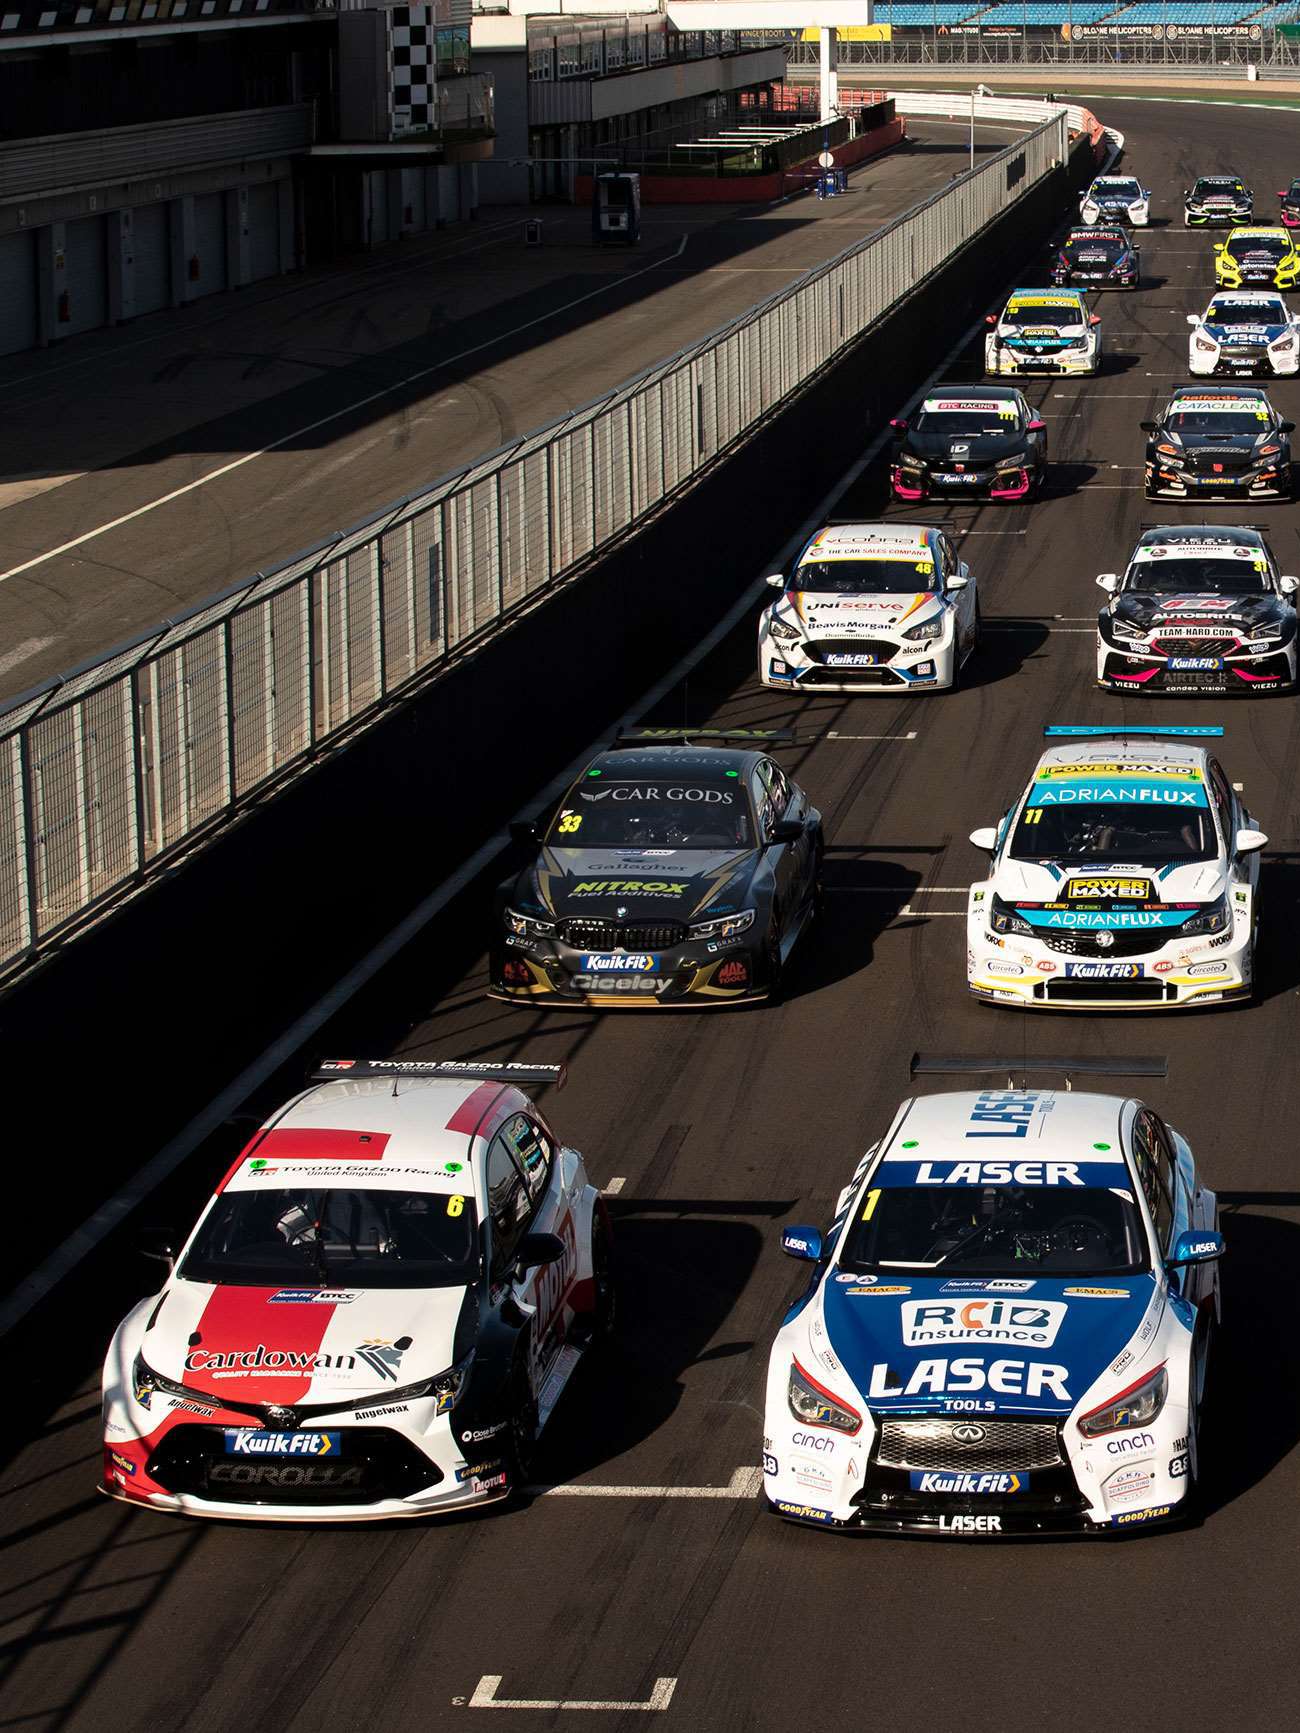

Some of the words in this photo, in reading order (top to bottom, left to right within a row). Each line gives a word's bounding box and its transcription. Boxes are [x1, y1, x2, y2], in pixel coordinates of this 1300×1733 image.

[1218, 334, 1270, 342] LASER
[1177, 402, 1260, 410] CATACLEAN
[915, 563, 931, 574] 48
[1254, 561, 1267, 573] 31
[1152, 613, 1243, 621] AUTOBRITE
[903, 646, 923, 654] alcon
[1115, 681, 1139, 689] VIEZU
[1163, 673, 1214, 683] AIRTEC
[1123, 766, 1191, 774] MAXED
[612, 787, 659, 800] CAR
[666, 789, 734, 804] GODS
[559, 815, 582, 832] 33
[1025, 809, 1043, 824] 11
[573, 882, 690, 893] NITROX
[1075, 880, 1145, 888] POWER
[1075, 887, 1146, 898] MAXED
[1038, 962, 1054, 970] ABS
[569, 974, 674, 993] Ciceley
[916, 1162, 1086, 1185] LASER
[447, 1195, 464, 1216] 6
[862, 1188, 881, 1221] 1
[784, 1236, 808, 1251] LASER
[1190, 1240, 1218, 1253] LASER
[911, 1328, 1047, 1344] Insurance
[185, 1344, 355, 1371] Cardowan
[868, 1358, 1072, 1400] LASER
[168, 1399, 213, 1417] Angelwax
[355, 1404, 409, 1421] Angelwax
[944, 1400, 995, 1412] TOOLS
[792, 1432, 835, 1452] cinch
[1107, 1433, 1154, 1454] cinch
[209, 1463, 365, 1485] COROLLA
[779, 1503, 826, 1519] GOODYEAR
[1118, 1507, 1170, 1523] GOODYEAR
[939, 1515, 1002, 1532] LASER
